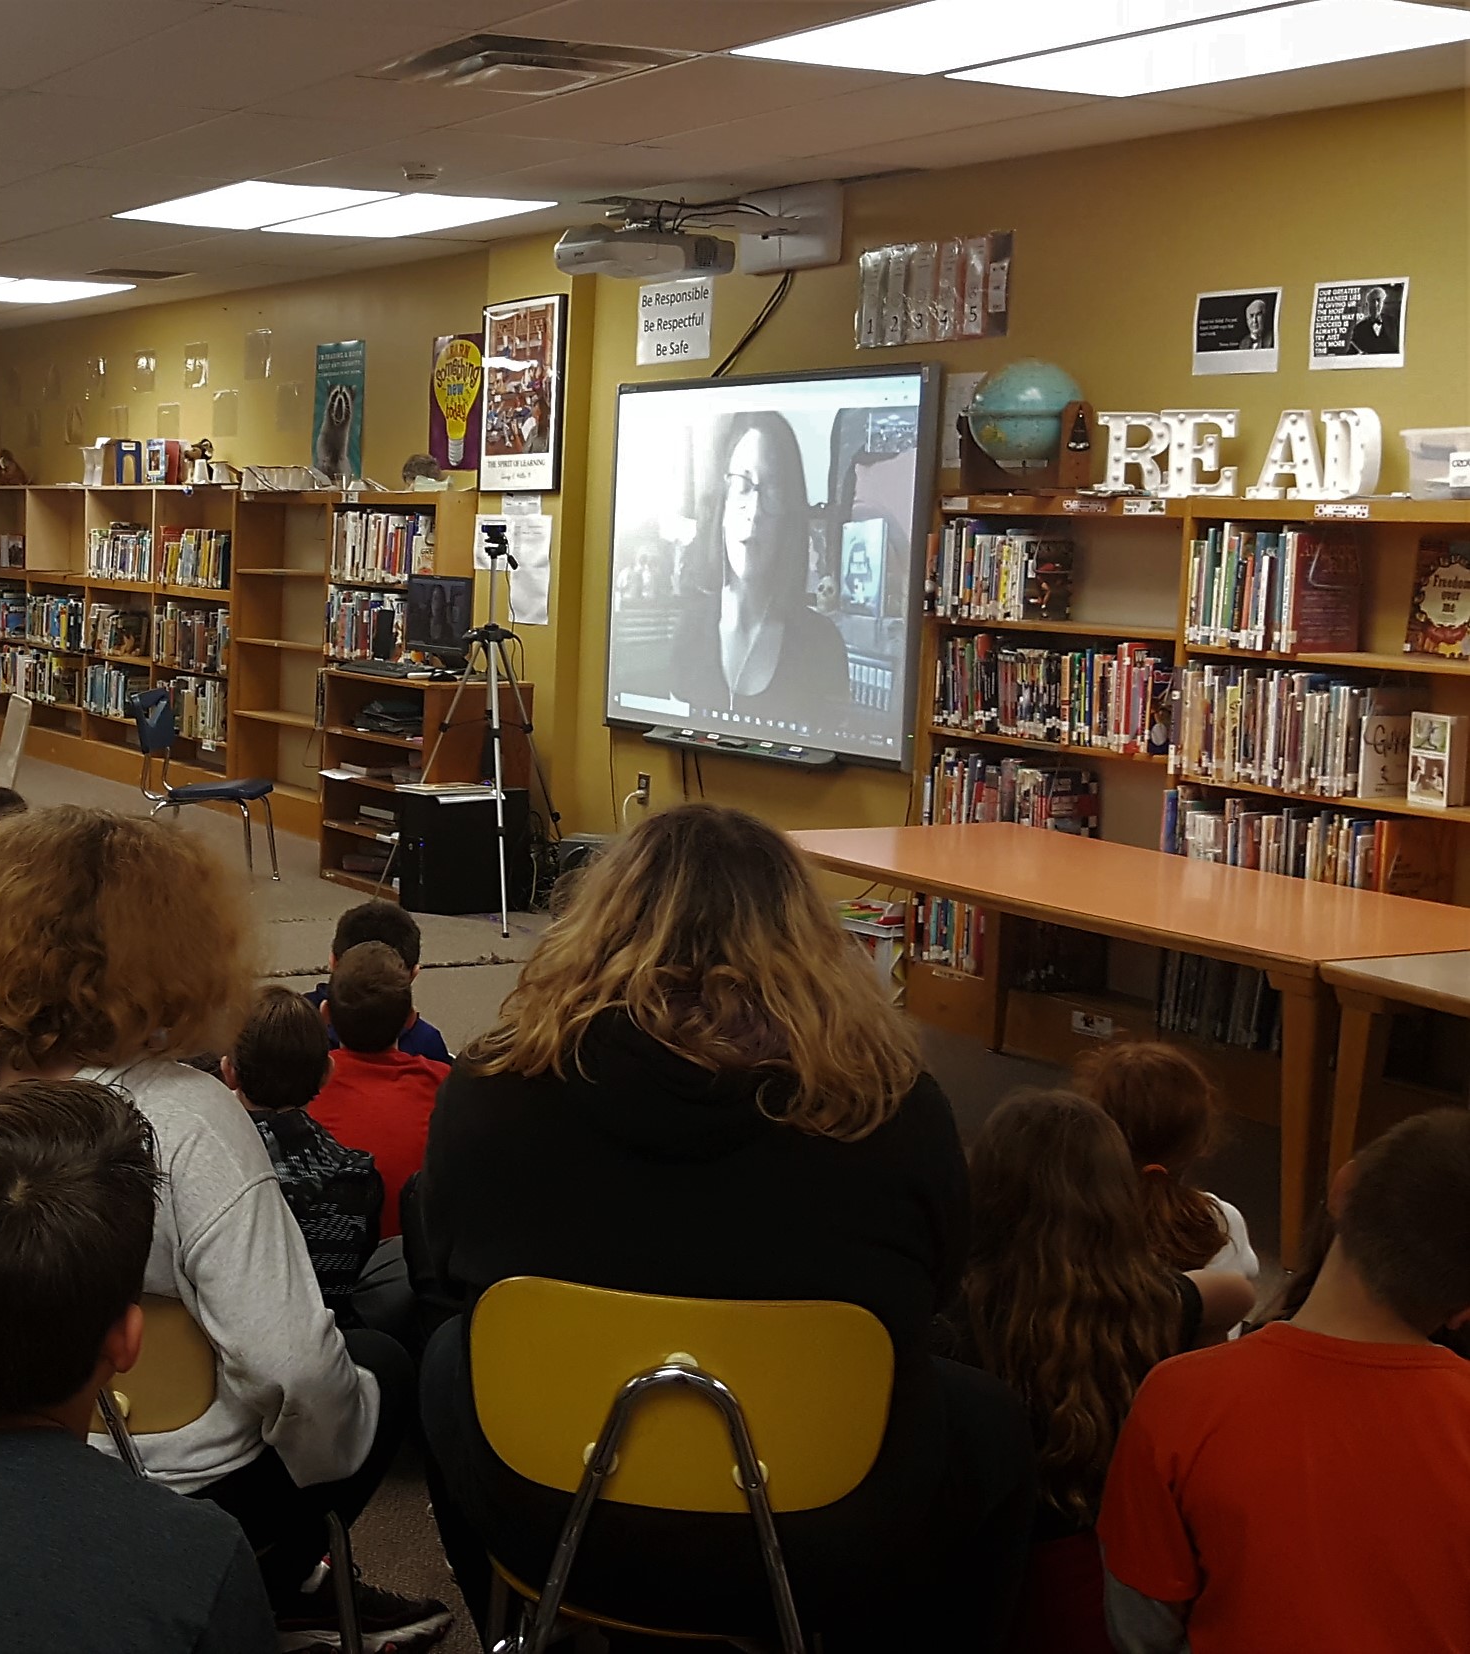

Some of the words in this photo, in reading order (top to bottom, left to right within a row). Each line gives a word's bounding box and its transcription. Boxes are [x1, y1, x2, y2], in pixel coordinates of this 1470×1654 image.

[641, 295, 653, 308] Be
[654, 285, 709, 307] Responsible
[643, 320, 655, 332] Be
[656, 312, 704, 332] Respectful
[969, 305, 978, 323] 5
[890, 315, 899, 333] 2
[656, 343, 668, 356] Be
[669, 340, 689, 355] Safe
[435, 358, 481, 389] something
[447, 383, 464, 396] new
[446, 403, 466, 422] today
[487, 460, 496, 468] THE
[497, 460, 513, 468] SPIRIT
[520, 458, 546, 467] LEARNING
[1093, 408, 1382, 500] READ
[1440, 591, 1462, 601] over
